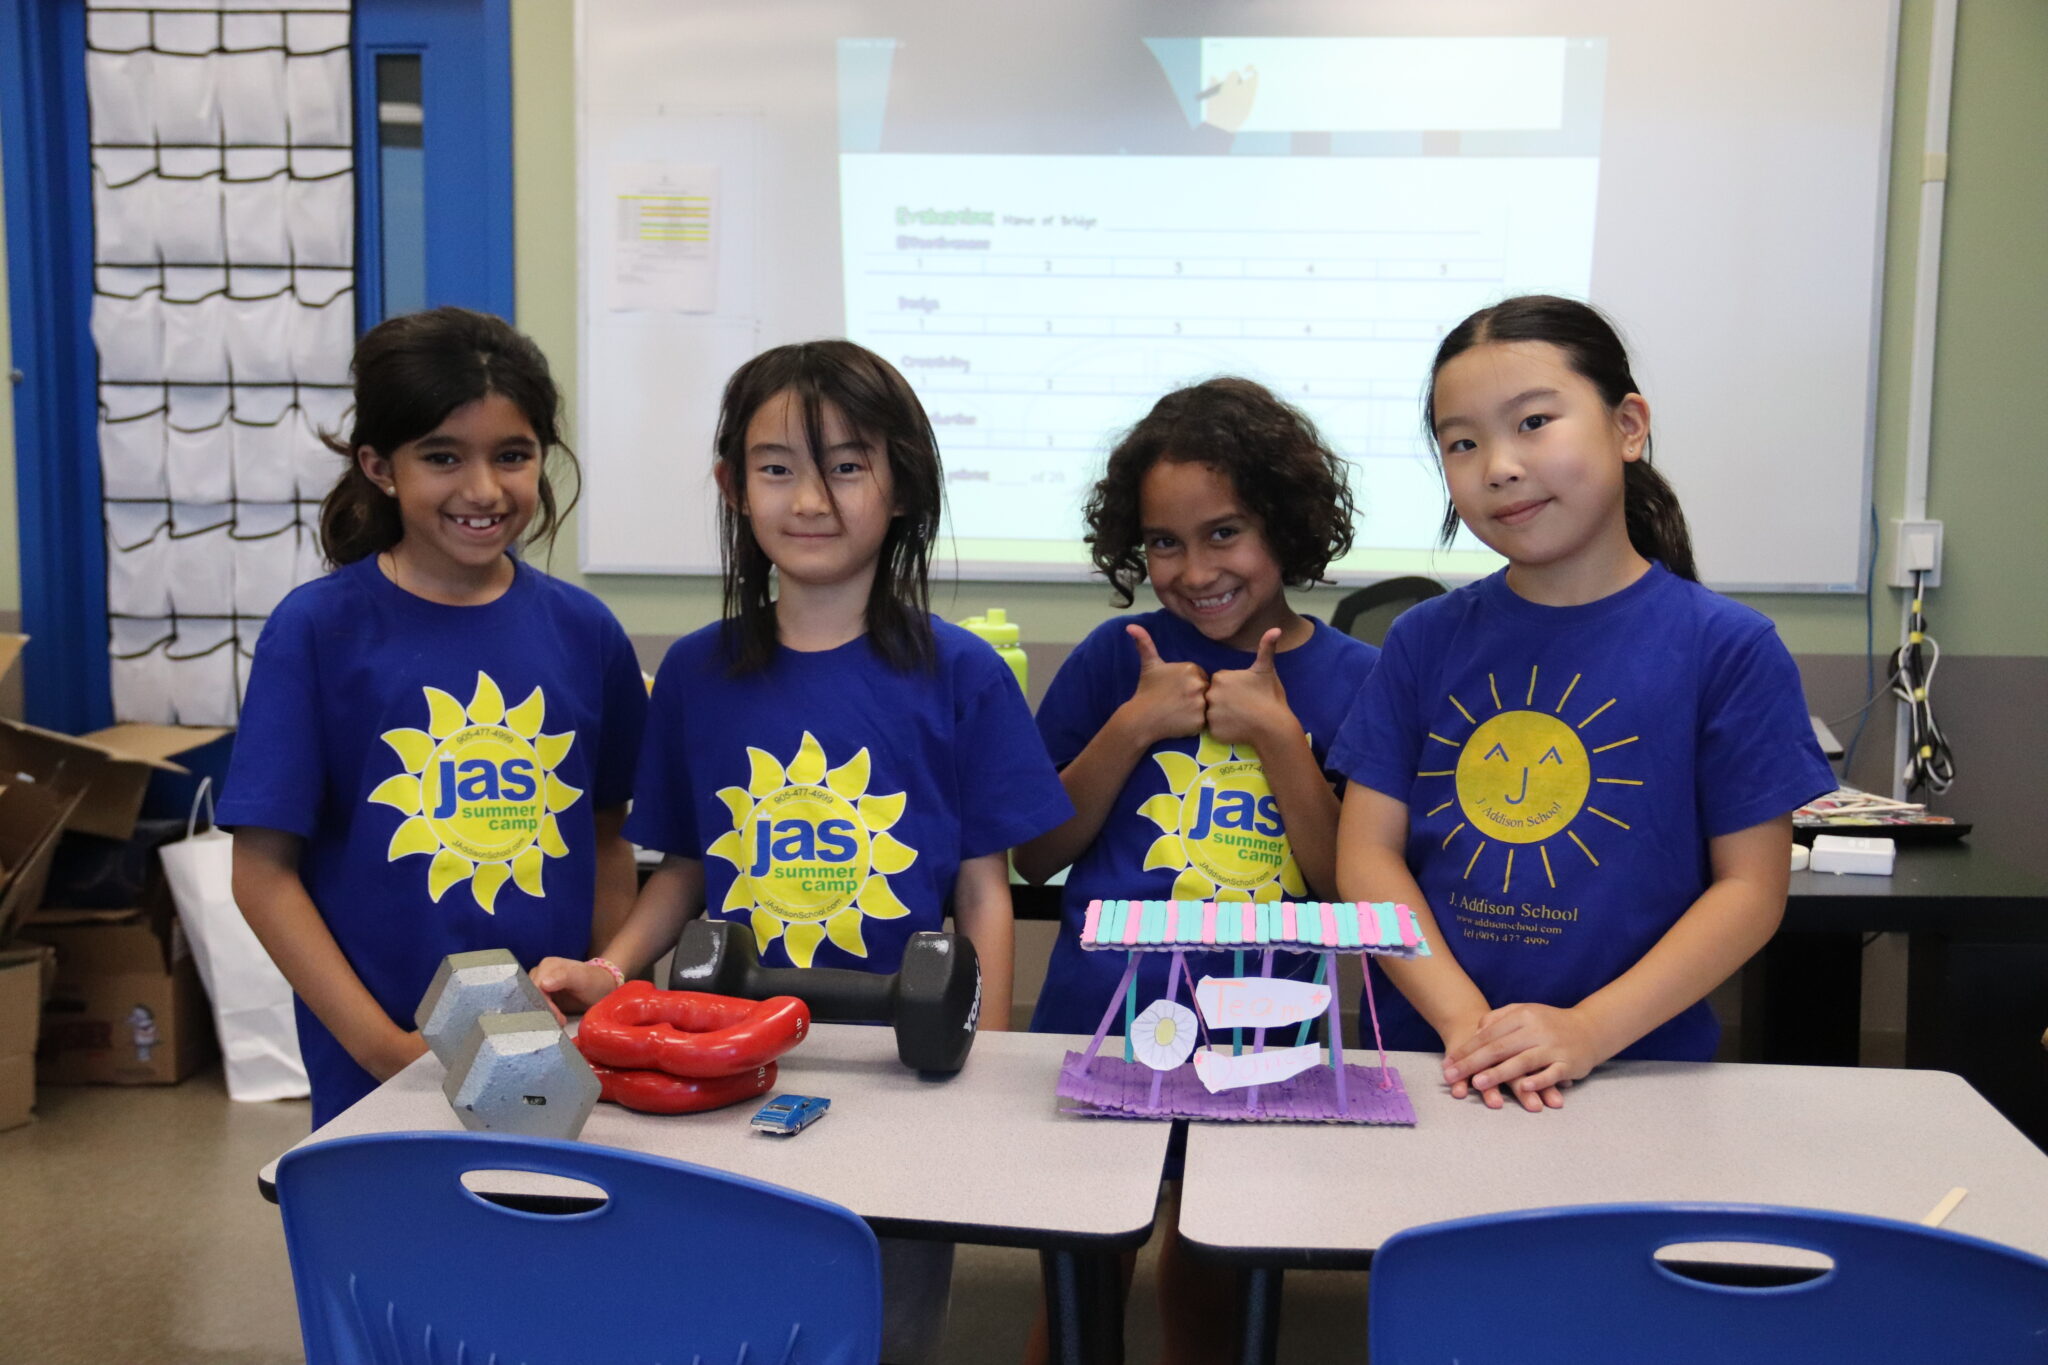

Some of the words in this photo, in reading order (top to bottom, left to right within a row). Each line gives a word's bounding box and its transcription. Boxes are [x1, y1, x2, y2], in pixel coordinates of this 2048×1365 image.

[456, 728, 514, 744] 905-477-4999
[433, 750, 537, 819] jas
[774, 788, 834, 804] 905-477-4999
[462, 805, 537, 819] summer
[1482, 806, 1524, 828] Addison
[1526, 801, 1562, 827] School
[488, 817, 538, 833] camp
[750, 809, 858, 878] jas
[1213, 832, 1285, 853] summer
[1237, 848, 1283, 868] camp
[774, 866, 857, 879] summer
[1199, 861, 1271, 886] JAddisonSchool.com
[801, 879, 858, 894] camp
[764, 898, 842, 919] JAddisonSchool.com
[1459, 895, 1516, 916] Addison
[1520, 902, 1579, 922] School
[1201, 979, 1305, 1024] Team
[757, 1066, 766, 1079] lb
